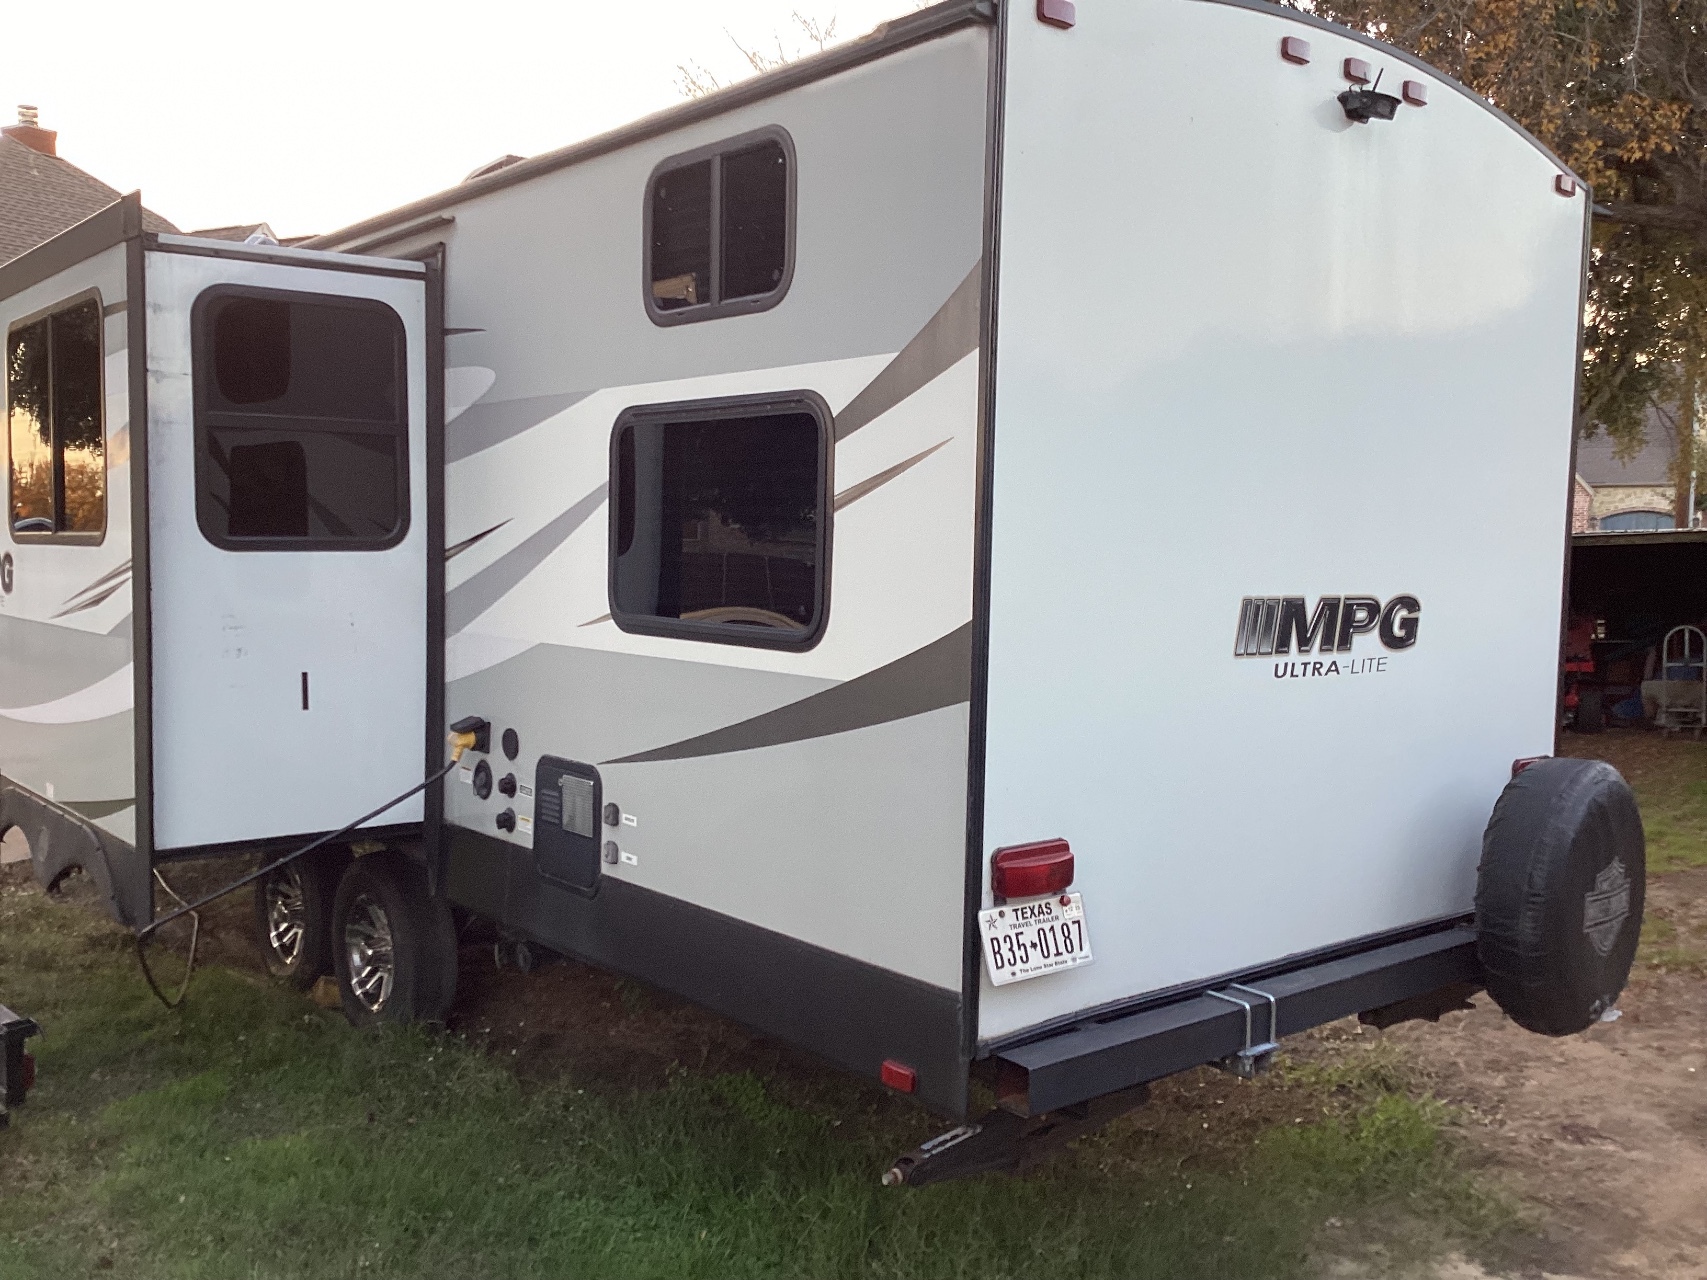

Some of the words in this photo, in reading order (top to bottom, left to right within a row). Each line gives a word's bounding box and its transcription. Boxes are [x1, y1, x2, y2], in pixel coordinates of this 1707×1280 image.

[1274, 593, 1421, 653] MPG
[1274, 656, 1388, 679] ULTRA-LITE
[1012, 902, 1053, 922] TEXAS
[1009, 921, 1033, 931] TRAVEL
[1034, 915, 1060, 926] TRAILER
